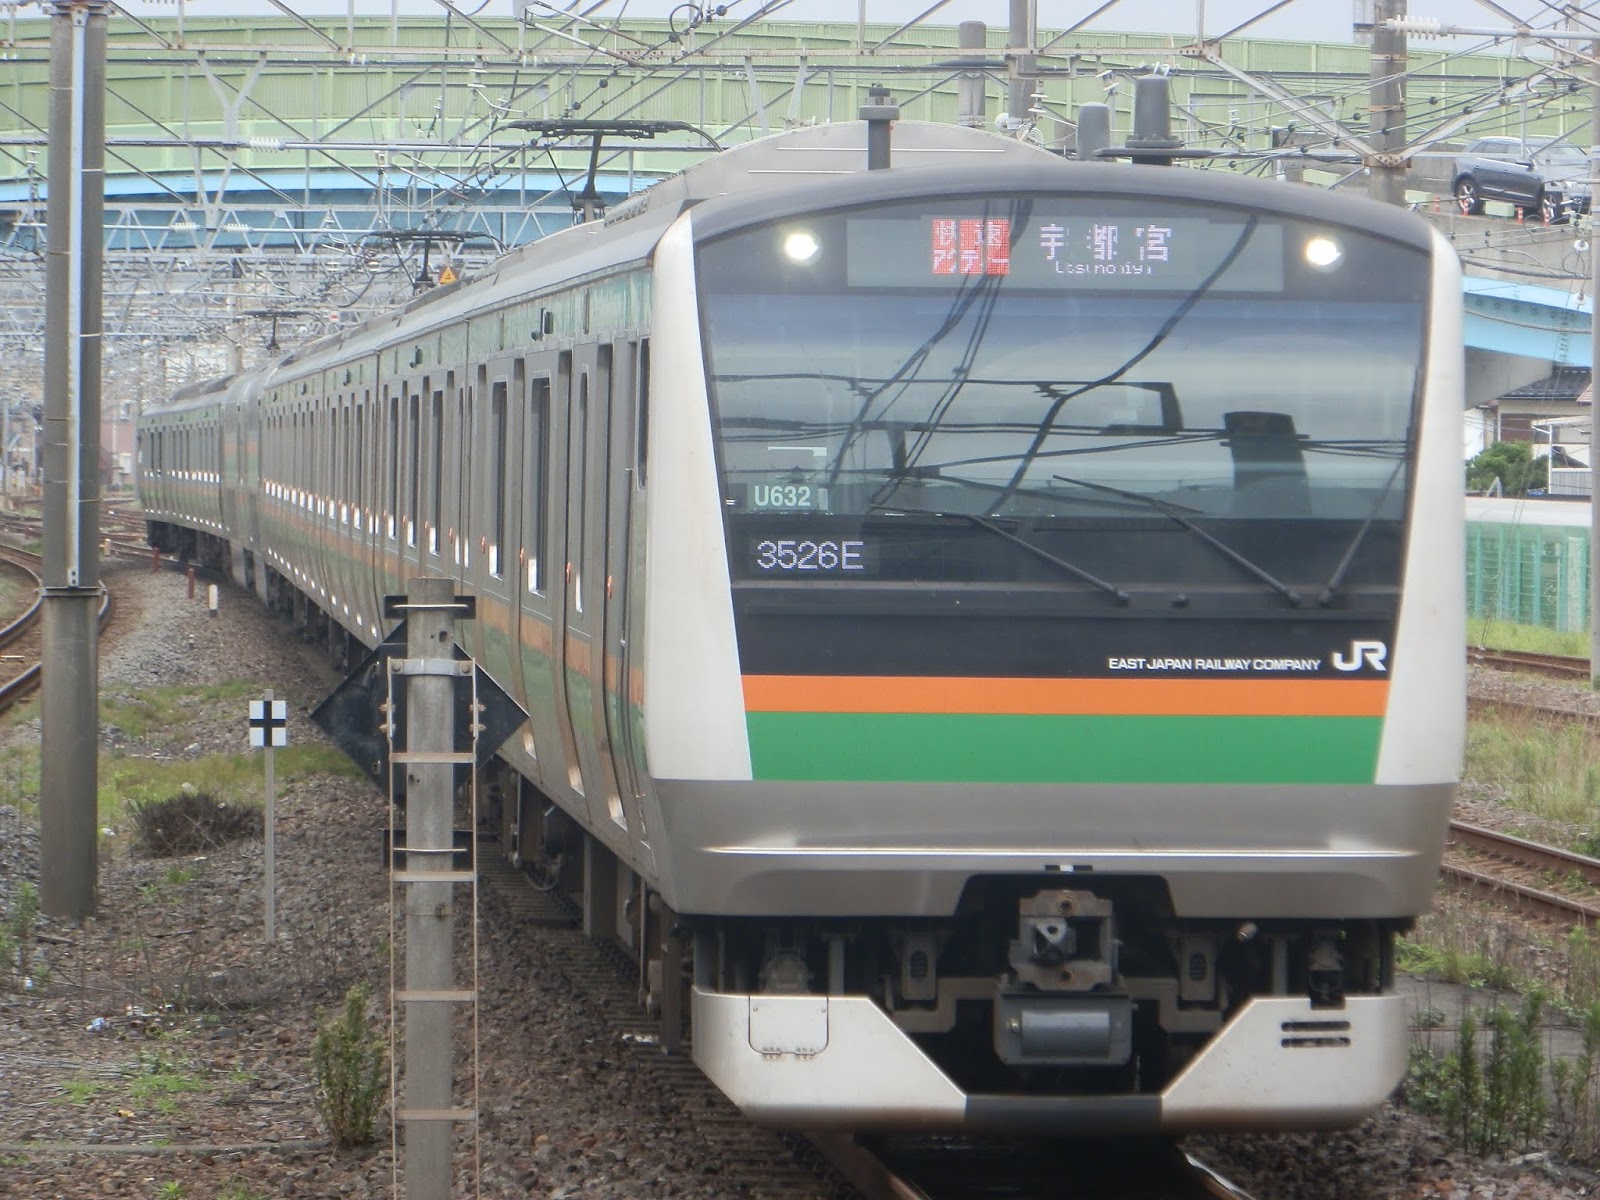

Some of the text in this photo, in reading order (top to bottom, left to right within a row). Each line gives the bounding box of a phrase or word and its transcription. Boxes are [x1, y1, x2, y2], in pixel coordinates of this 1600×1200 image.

[754, 485, 811, 507] U632
[757, 540, 864, 570] 3526E
[1108, 658, 1321, 671] EAST JAPAN RAILWAY COMPANY
[1333, 641, 1387, 672] JR
